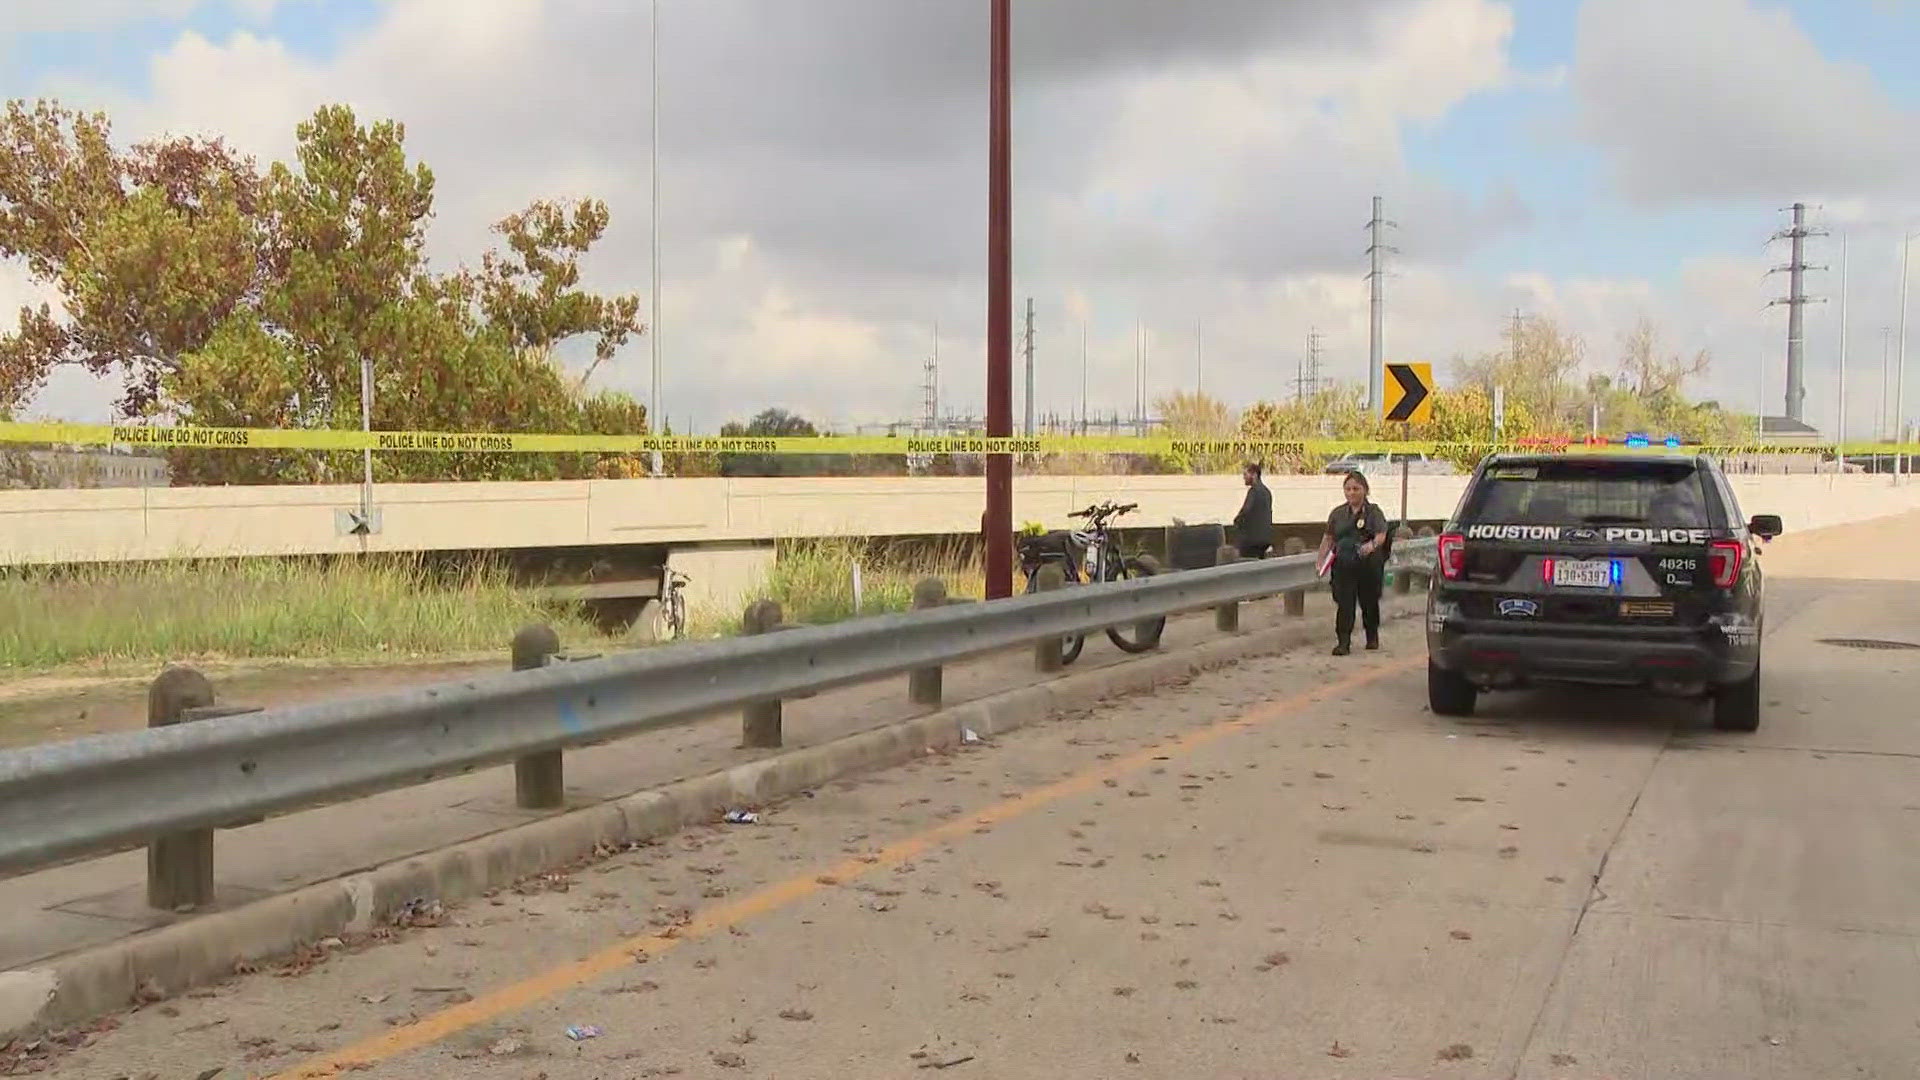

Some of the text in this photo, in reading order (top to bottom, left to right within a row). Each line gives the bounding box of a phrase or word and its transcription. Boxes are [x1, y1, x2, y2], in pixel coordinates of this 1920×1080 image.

[113, 427, 249, 445] POLICE LINE DO NOT CROSS
[379, 435, 513, 450] POLICE LINE DO NOT CROSS
[643, 440, 677, 450] POLICE
[705, 441, 719, 450] DO
[721, 441, 742, 450] NOT
[744, 441, 777, 450] CROSS
[907, 439, 1041, 452] POLICE LINE DO NOT CROSS
[1171, 442, 1304, 454] POLICE LINE DO NOT CROSS
[1468, 524, 1561, 541] HOUSTON
[1605, 527, 1709, 545] POLICE
